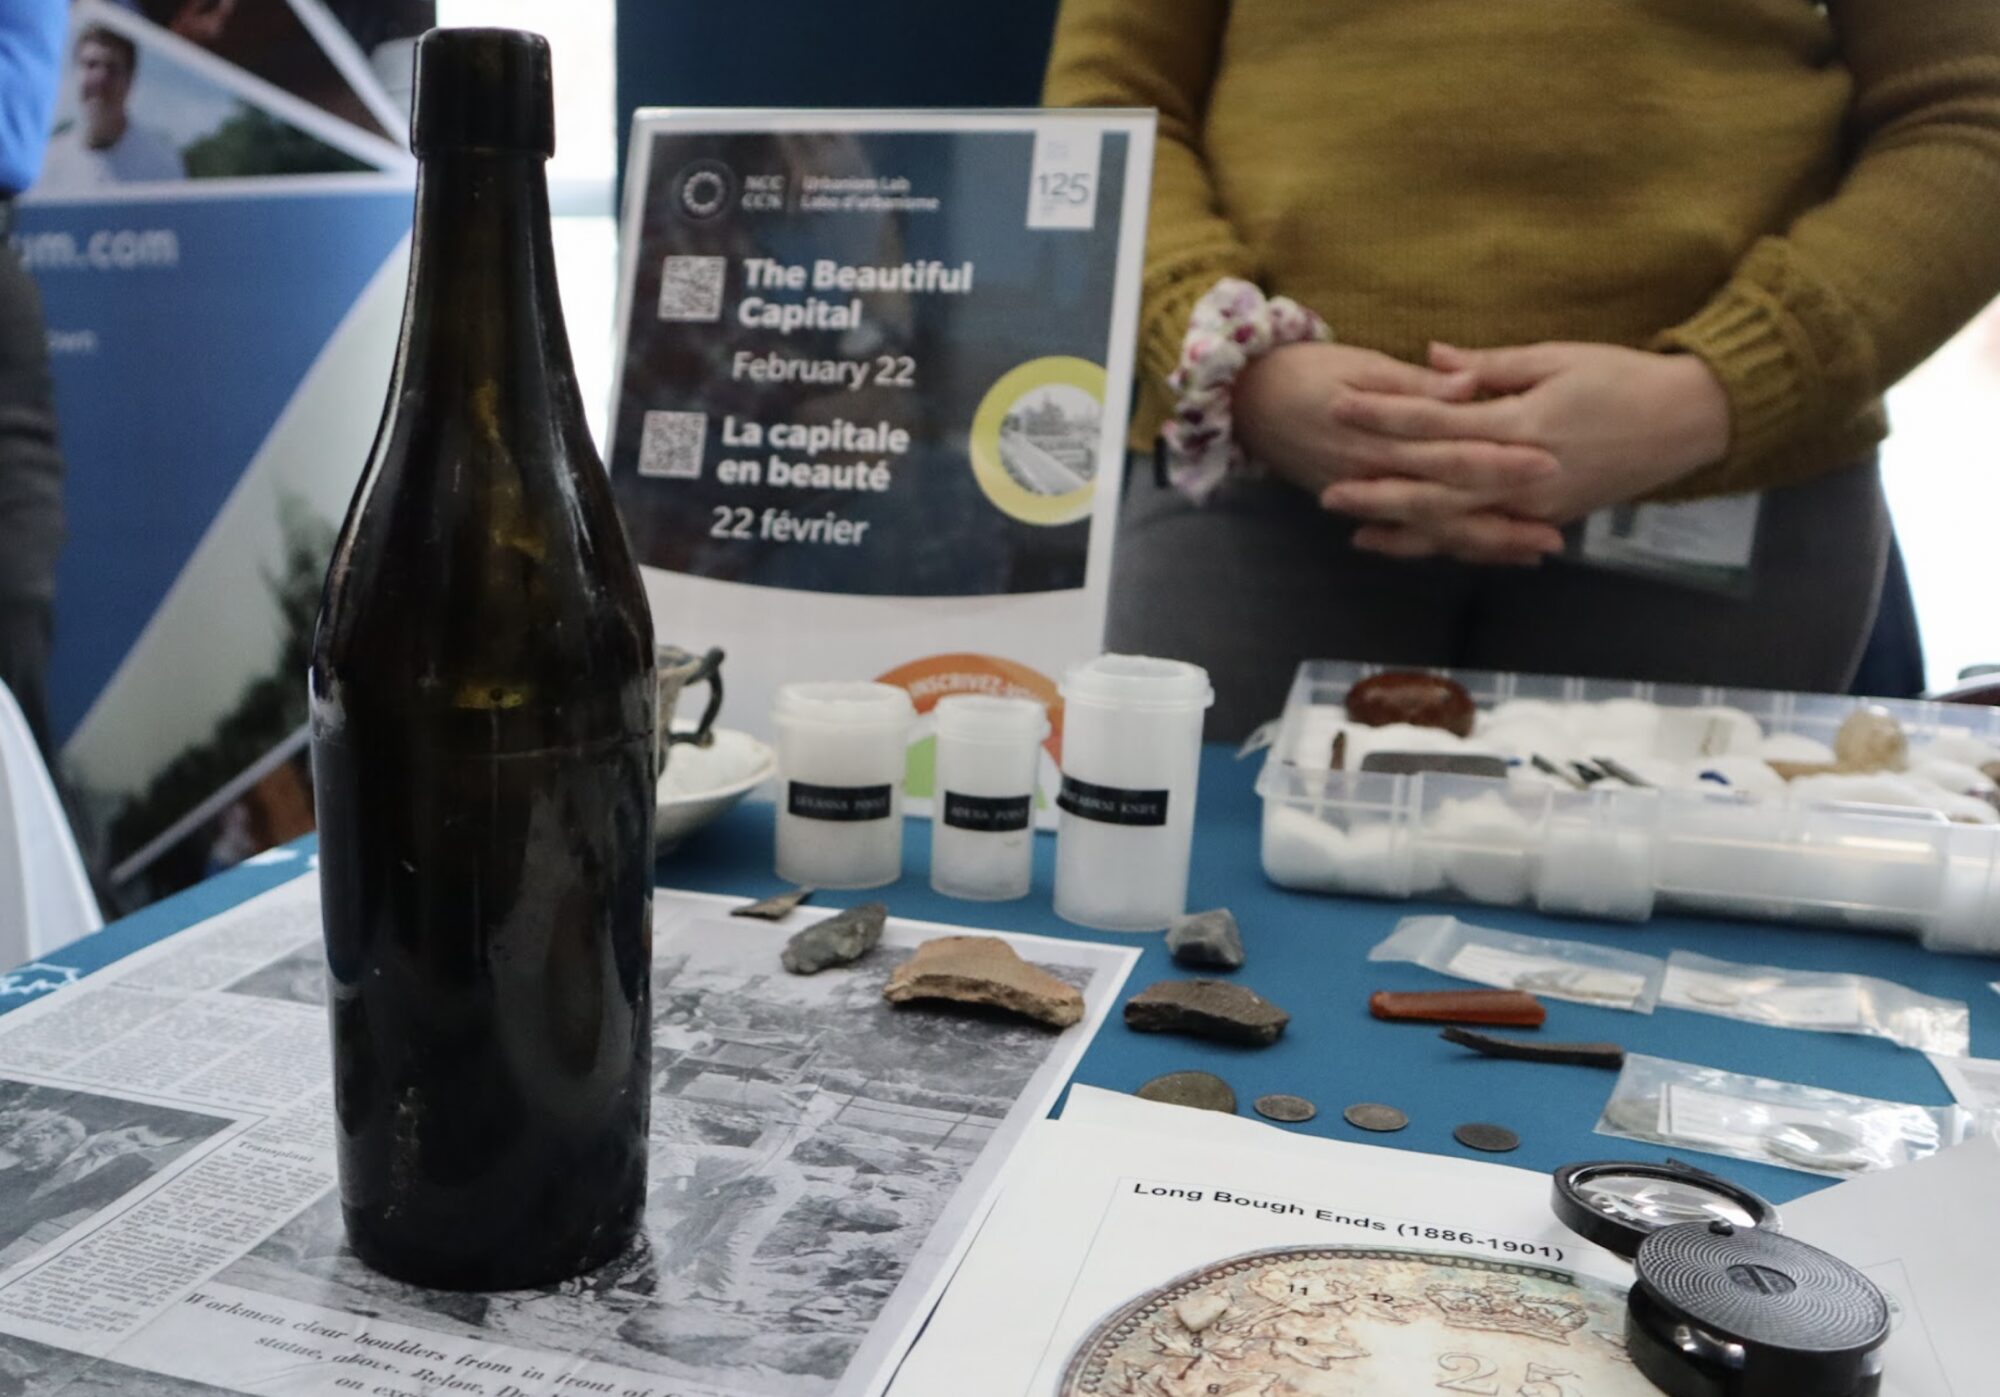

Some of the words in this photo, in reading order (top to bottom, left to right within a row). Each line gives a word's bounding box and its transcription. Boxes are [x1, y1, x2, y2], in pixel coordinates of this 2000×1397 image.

[1038, 171, 1092, 206] 125
[743, 257, 807, 289] The
[812, 258, 975, 293] Beautiful
[738, 297, 862, 333] Capital
[732, 351, 869, 389] February
[873, 356, 916, 387] 22
[722, 415, 763, 448] La
[767, 418, 910, 456] capitale
[716, 459, 760, 485] en
[766, 457, 891, 492] beauté
[710, 506, 754, 539] 22
[759, 507, 869, 545] février
[1133, 1182, 1203, 1202] Long
[1213, 1190, 1305, 1216] Bough
[1315, 1208, 1387, 1232] Ends
[1396, 1222, 1565, 1262] (1886-1901)
[184, 1292, 285, 1326] Workmen
[292, 1320, 348, 1340] clear
[354, 1332, 448, 1362] boulders
[454, 1353, 513, 1374] from
[520, 1365, 545, 1380] in
[554, 1372, 616, 1395] front
[254, 1335, 323, 1361] statue,
[331, 1352, 401, 1374] above.
[410, 1367, 485, 1396] Below,
[334, 1378, 365, 1391] on
